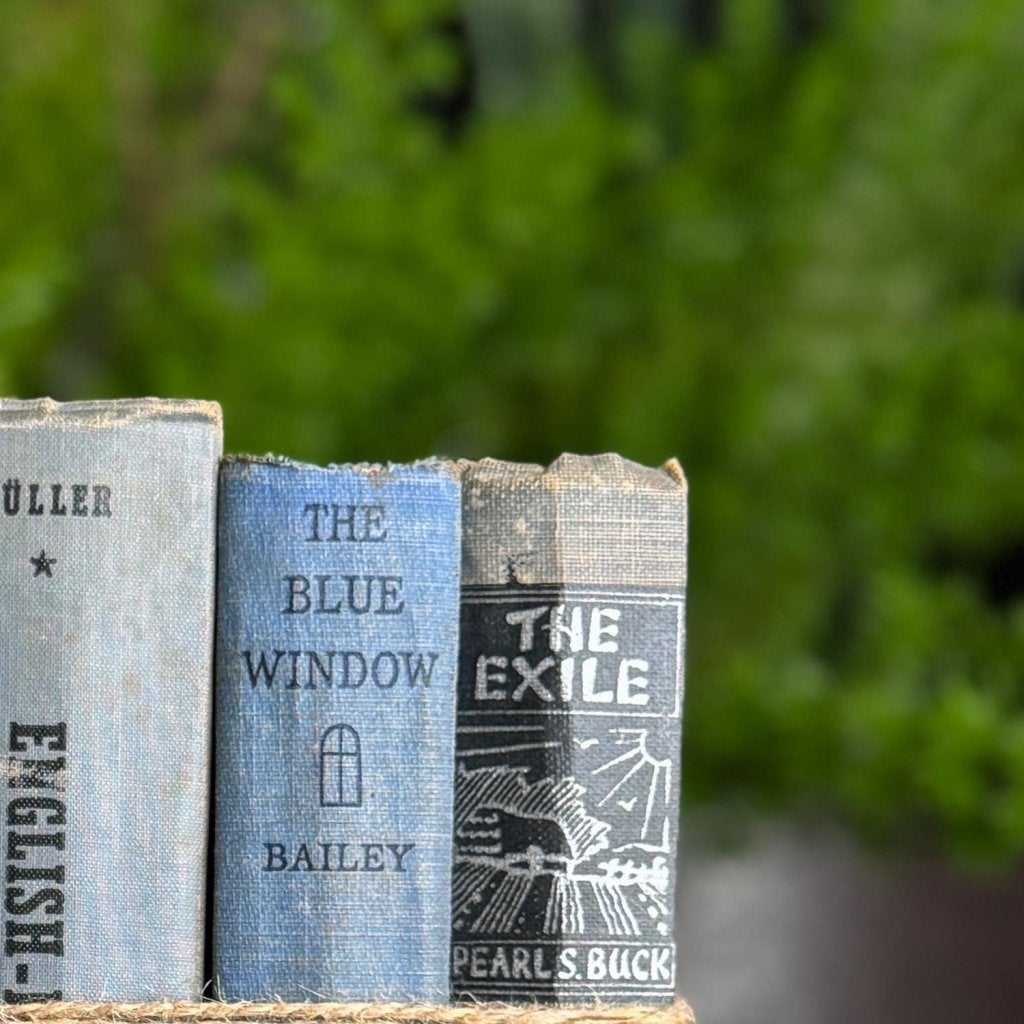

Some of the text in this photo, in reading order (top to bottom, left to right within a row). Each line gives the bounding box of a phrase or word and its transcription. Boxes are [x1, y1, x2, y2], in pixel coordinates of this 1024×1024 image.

[303, 502, 389, 543] THE
[286, 574, 407, 616] BLUE
[505, 604, 623, 655] THE
[242, 649, 440, 690] WINDOW
[476, 658, 651, 705] EXILE
[264, 842, 416, 873] BAILEY
[453, 946, 671, 982] PEARL S. BUCK
